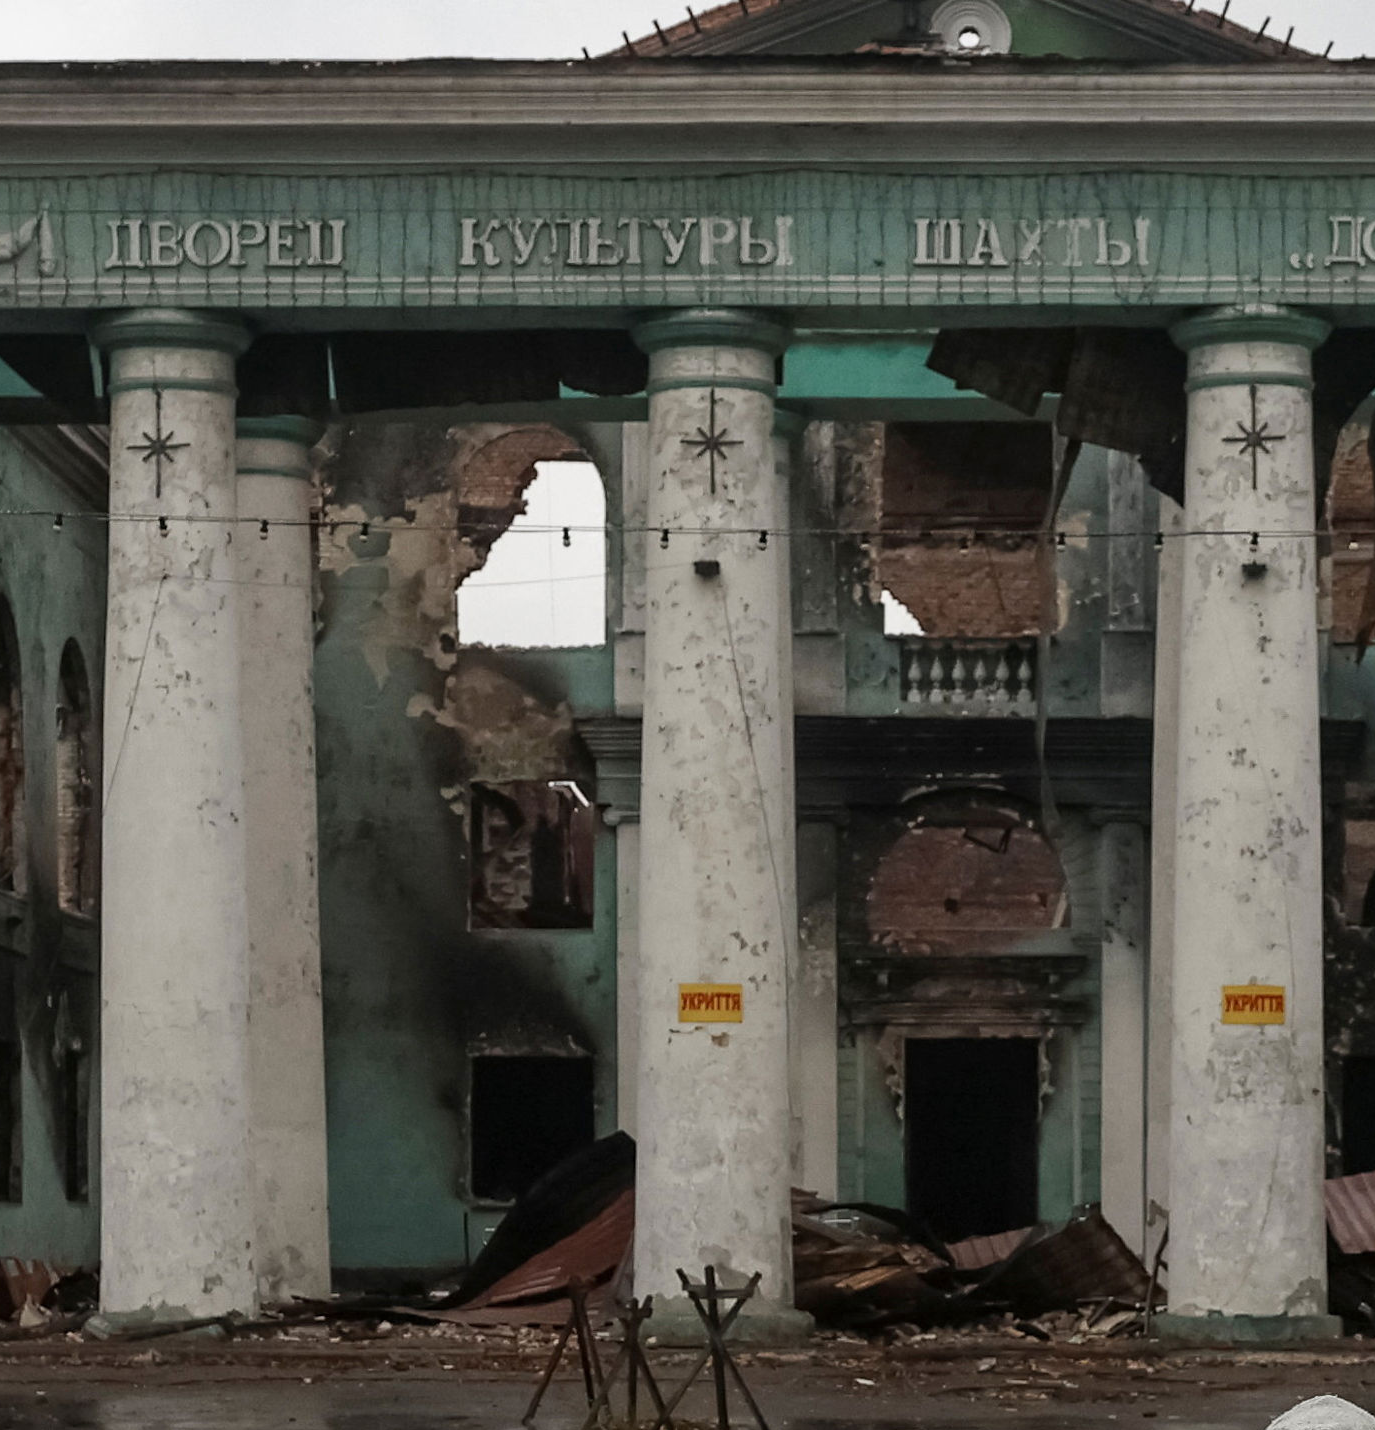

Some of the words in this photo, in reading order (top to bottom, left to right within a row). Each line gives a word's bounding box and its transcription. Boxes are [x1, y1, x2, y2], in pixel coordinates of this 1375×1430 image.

[104, 218, 346, 268] ДВОРЕЦ
[458, 216, 795, 266] КУЛЬТУРЫ
[912, 216, 1151, 267] ШАХТЫ
[681, 993, 741, 1011] УКРИТТЯ
[1225, 994, 1284, 1012] УКРИТТЯ
